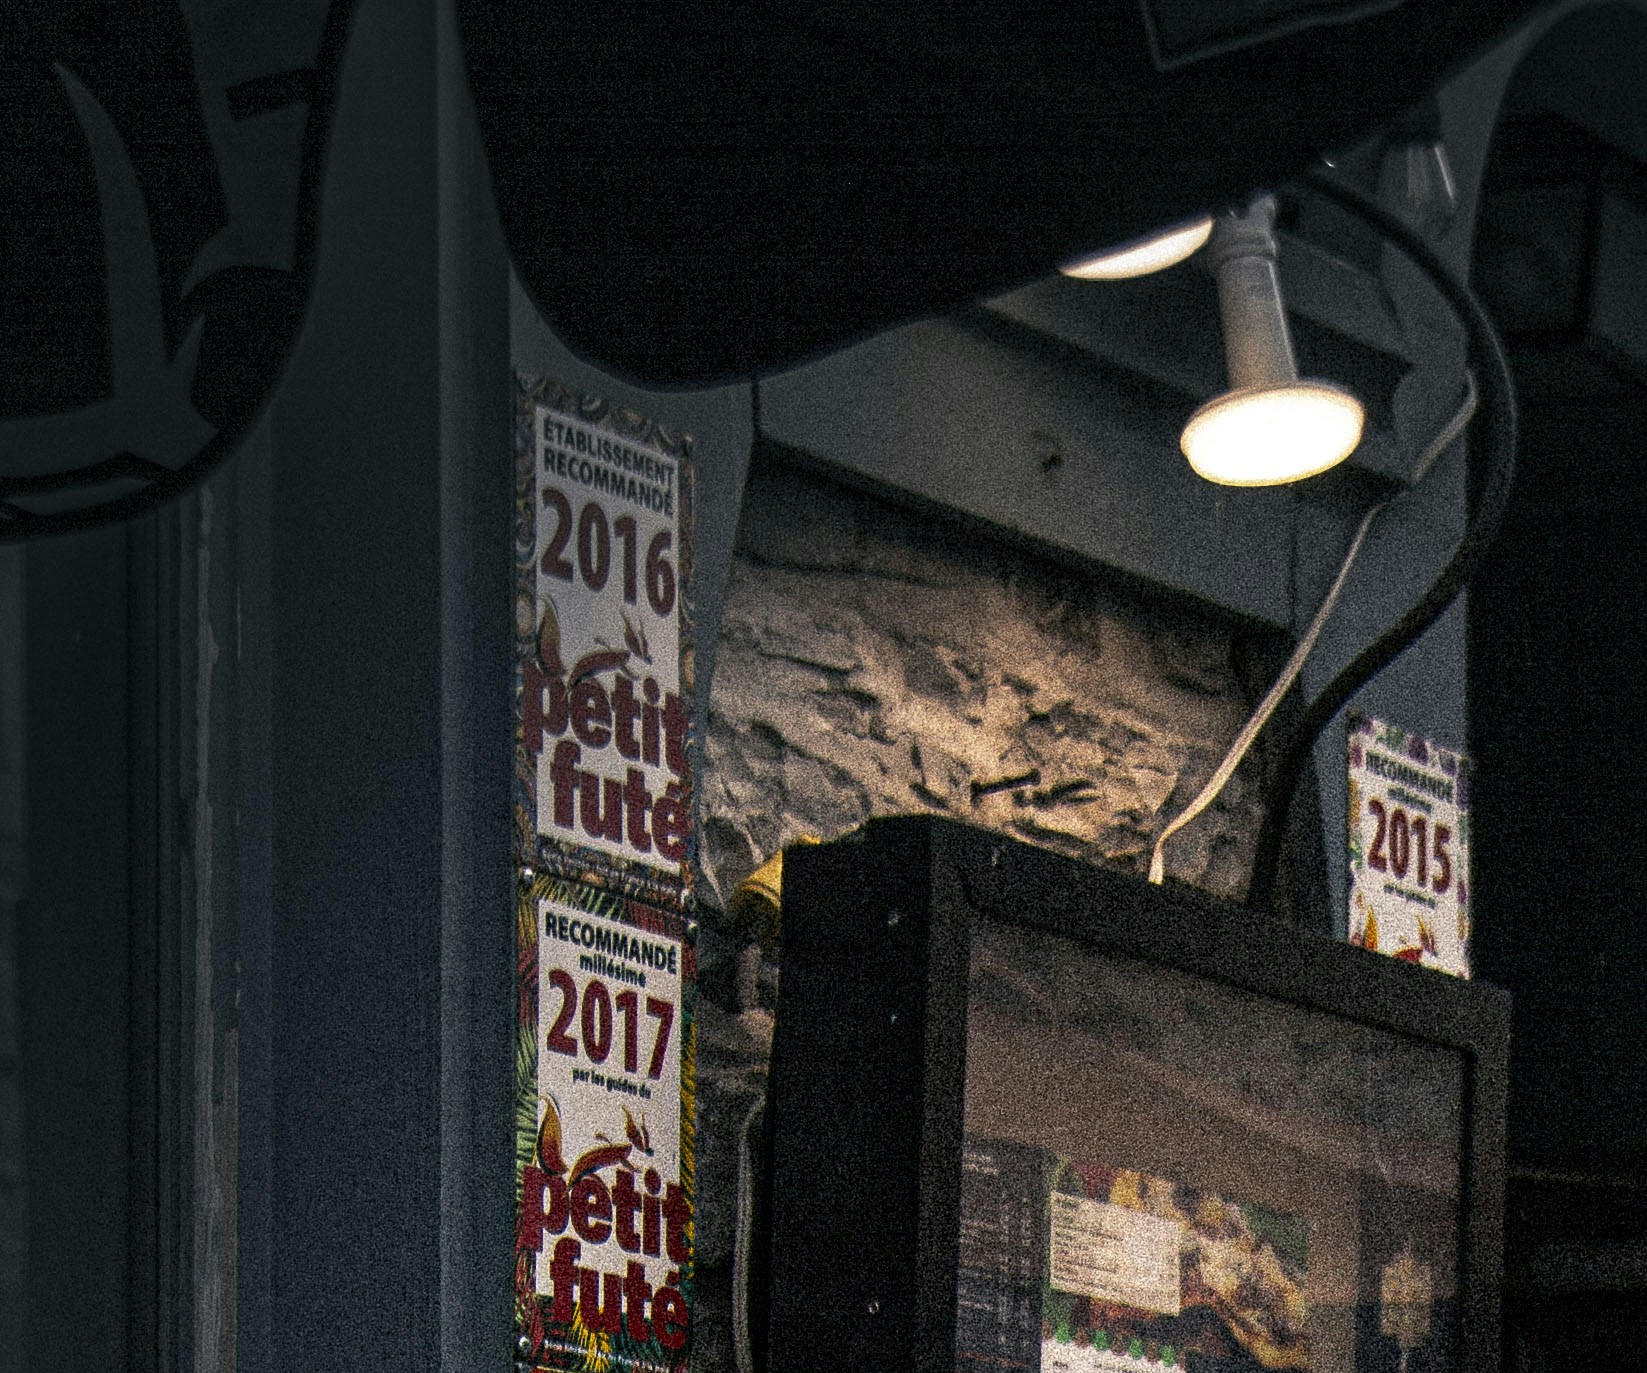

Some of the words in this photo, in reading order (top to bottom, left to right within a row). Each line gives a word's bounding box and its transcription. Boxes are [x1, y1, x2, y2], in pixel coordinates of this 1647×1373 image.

[541, 487, 676, 618] 2016
[522, 660, 688, 778] petit
[1367, 798, 1452, 895] 2015
[545, 911, 677, 975] RECOMMANDÉ
[547, 968, 674, 1080] 2017
[523, 1166, 690, 1264] petit
[551, 1237, 689, 1350] futé
